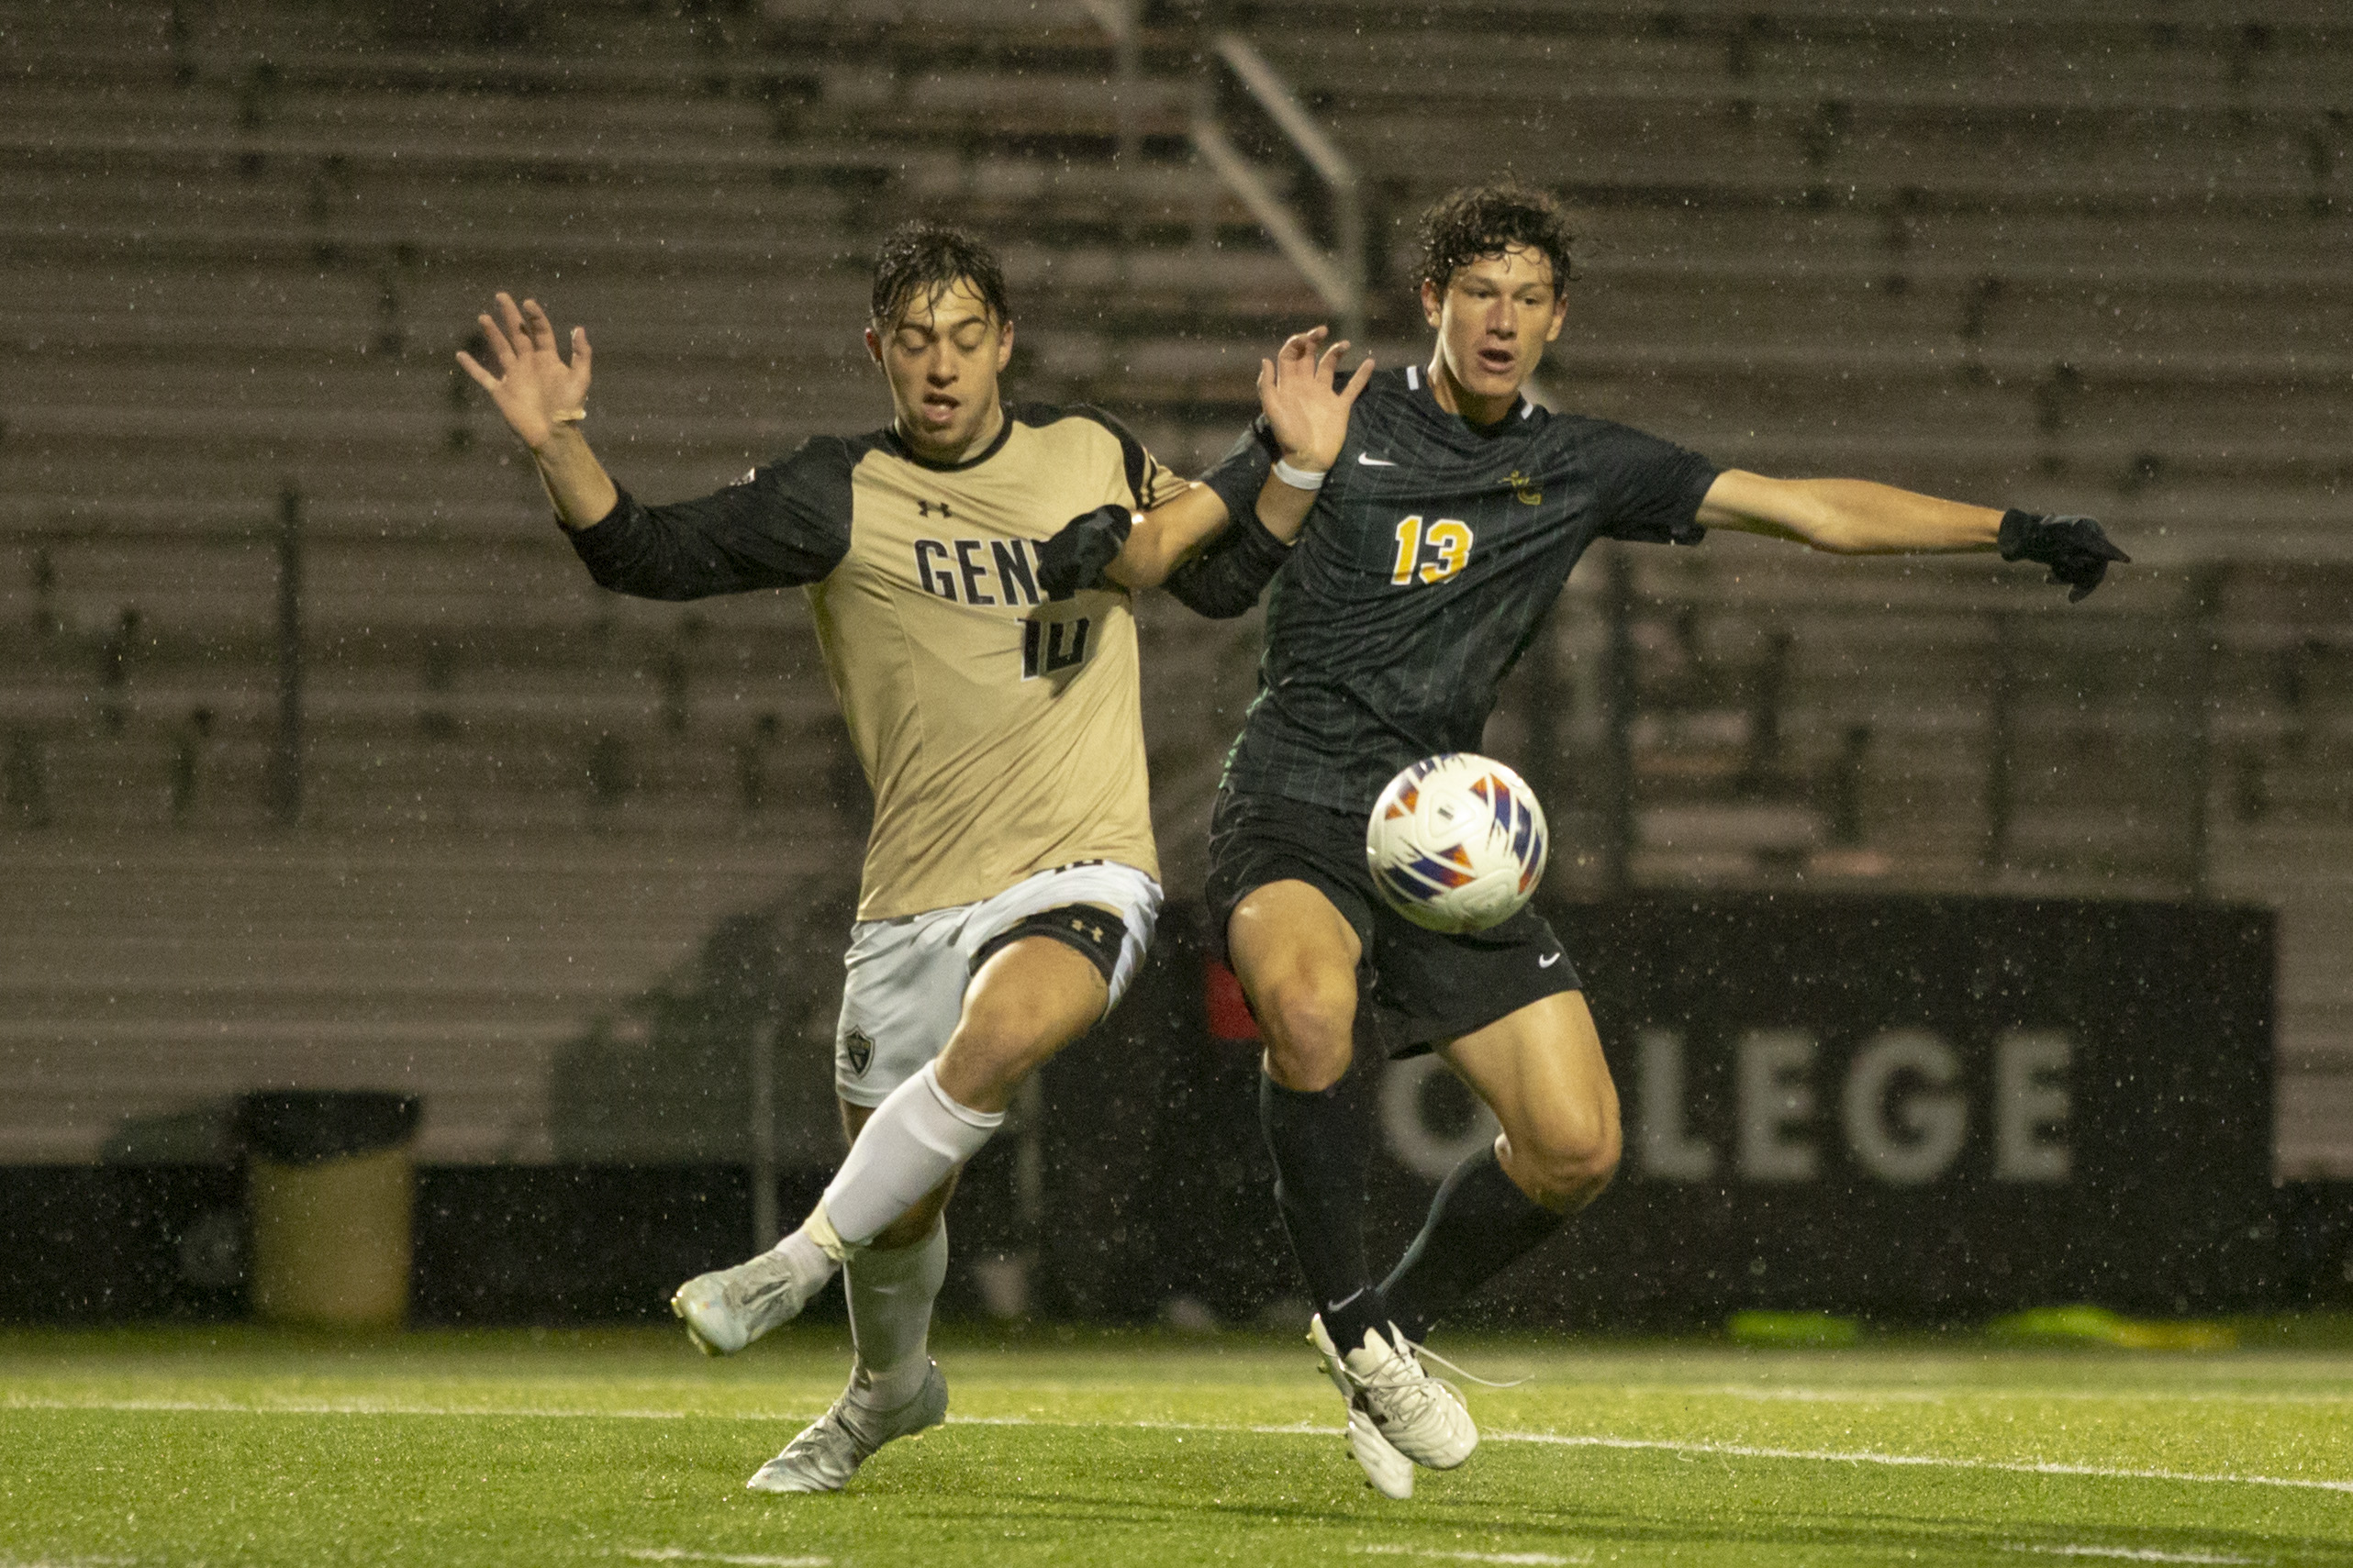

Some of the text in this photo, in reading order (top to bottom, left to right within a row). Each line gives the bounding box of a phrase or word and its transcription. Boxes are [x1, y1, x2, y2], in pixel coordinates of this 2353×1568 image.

[913, 538, 1049, 608] GEN
[1390, 515, 1474, 585] 13
[1377, 1027, 2076, 1185] OLEGE
